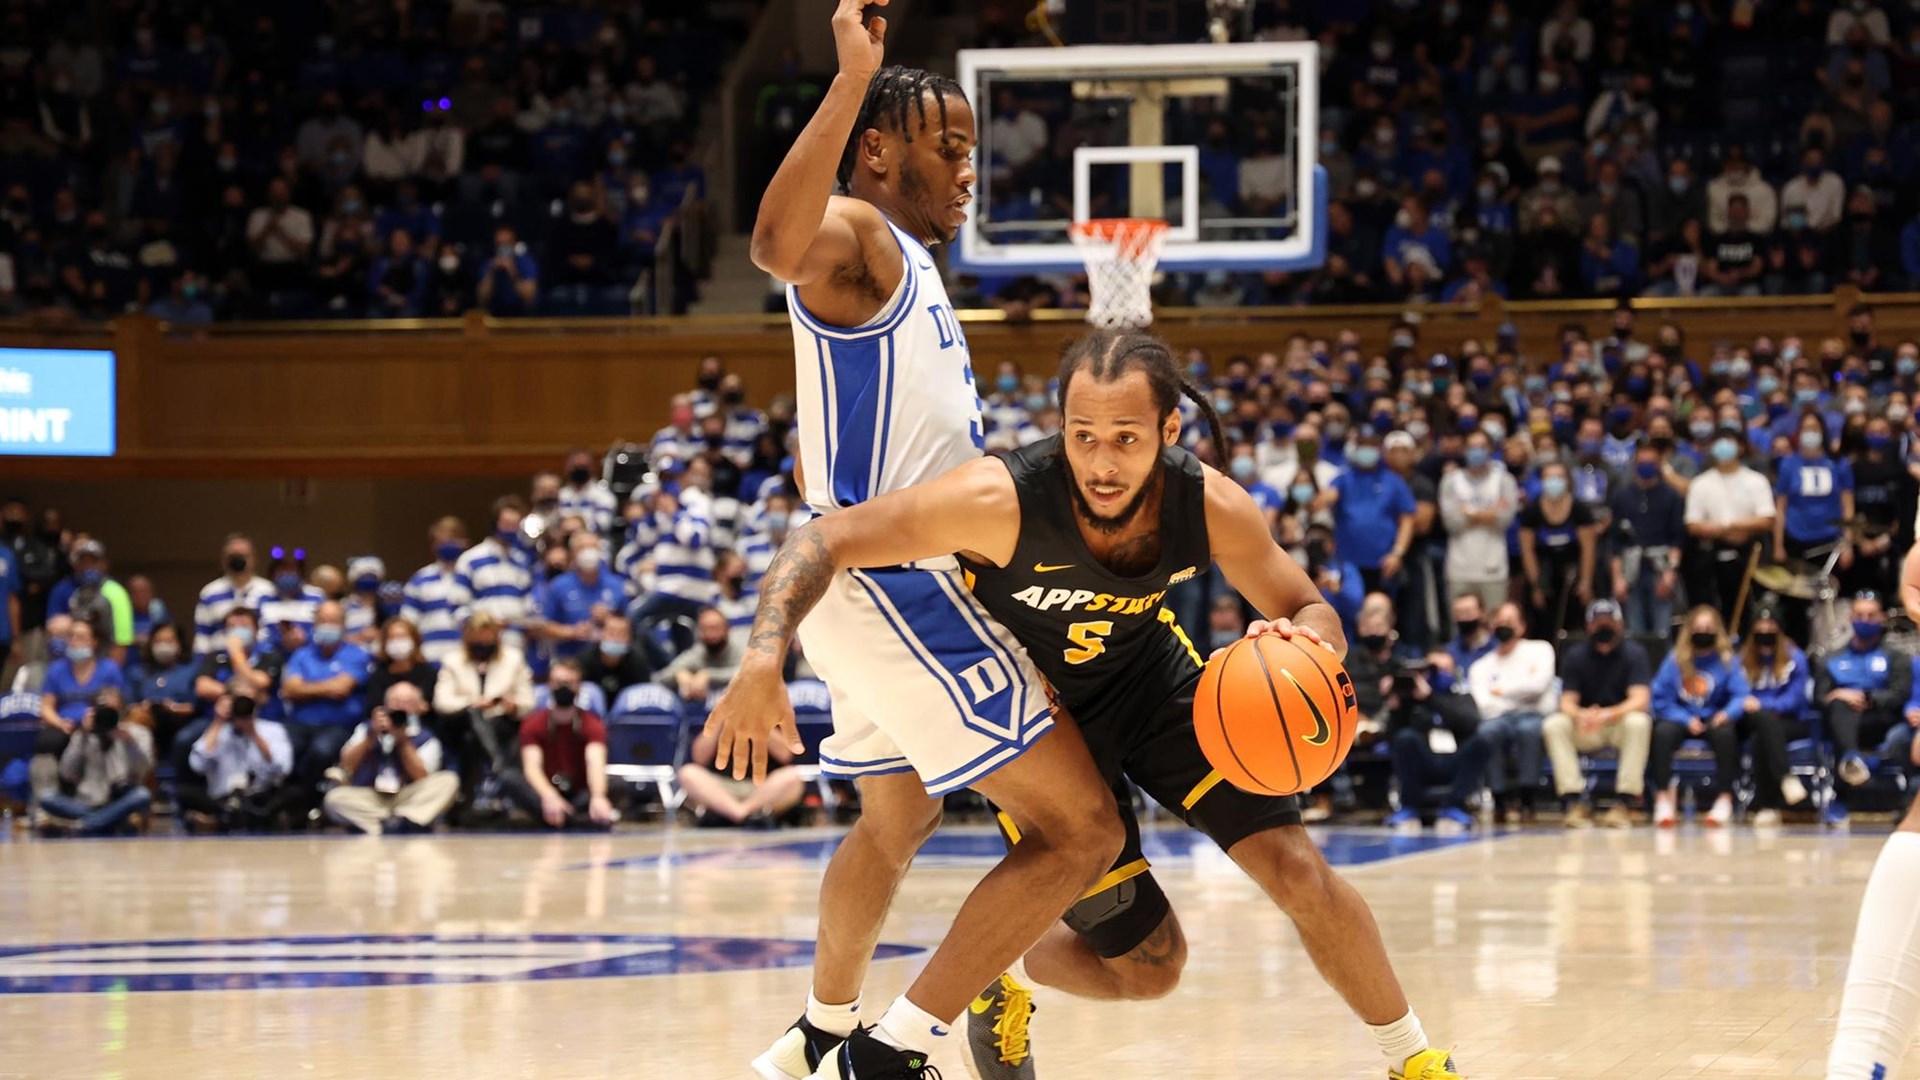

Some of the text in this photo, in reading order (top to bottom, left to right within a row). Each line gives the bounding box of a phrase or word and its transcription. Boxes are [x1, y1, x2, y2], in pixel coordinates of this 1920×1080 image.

[1800, 466, 1832, 497] D
[1064, 621, 1114, 665] 5
[957, 656, 1009, 705] D
